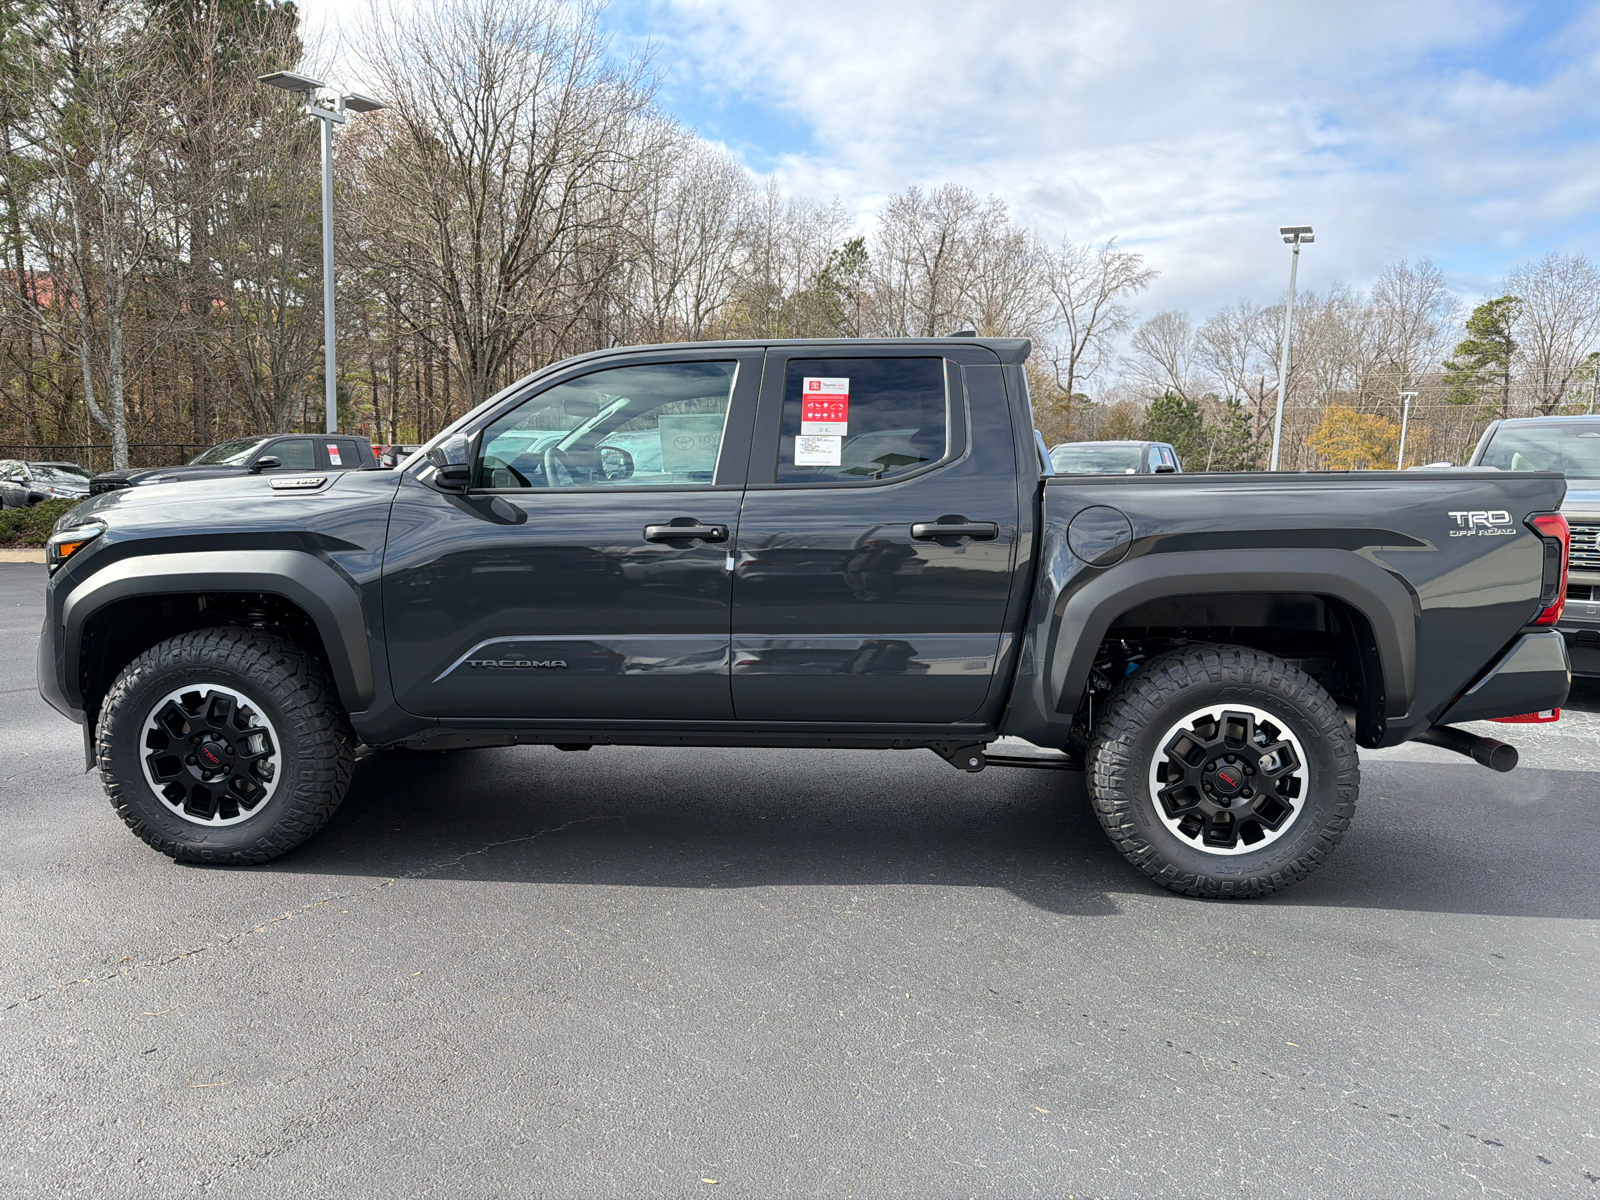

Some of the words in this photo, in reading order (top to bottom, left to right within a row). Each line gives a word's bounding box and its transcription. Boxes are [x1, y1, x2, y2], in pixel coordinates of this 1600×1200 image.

[1447, 510, 1513, 528] TRD
[1478, 528, 1517, 536] ROAD
[465, 659, 568, 669] TACOMA
[203, 747, 220, 764] TRD
[1219, 772, 1237, 788] TRD
